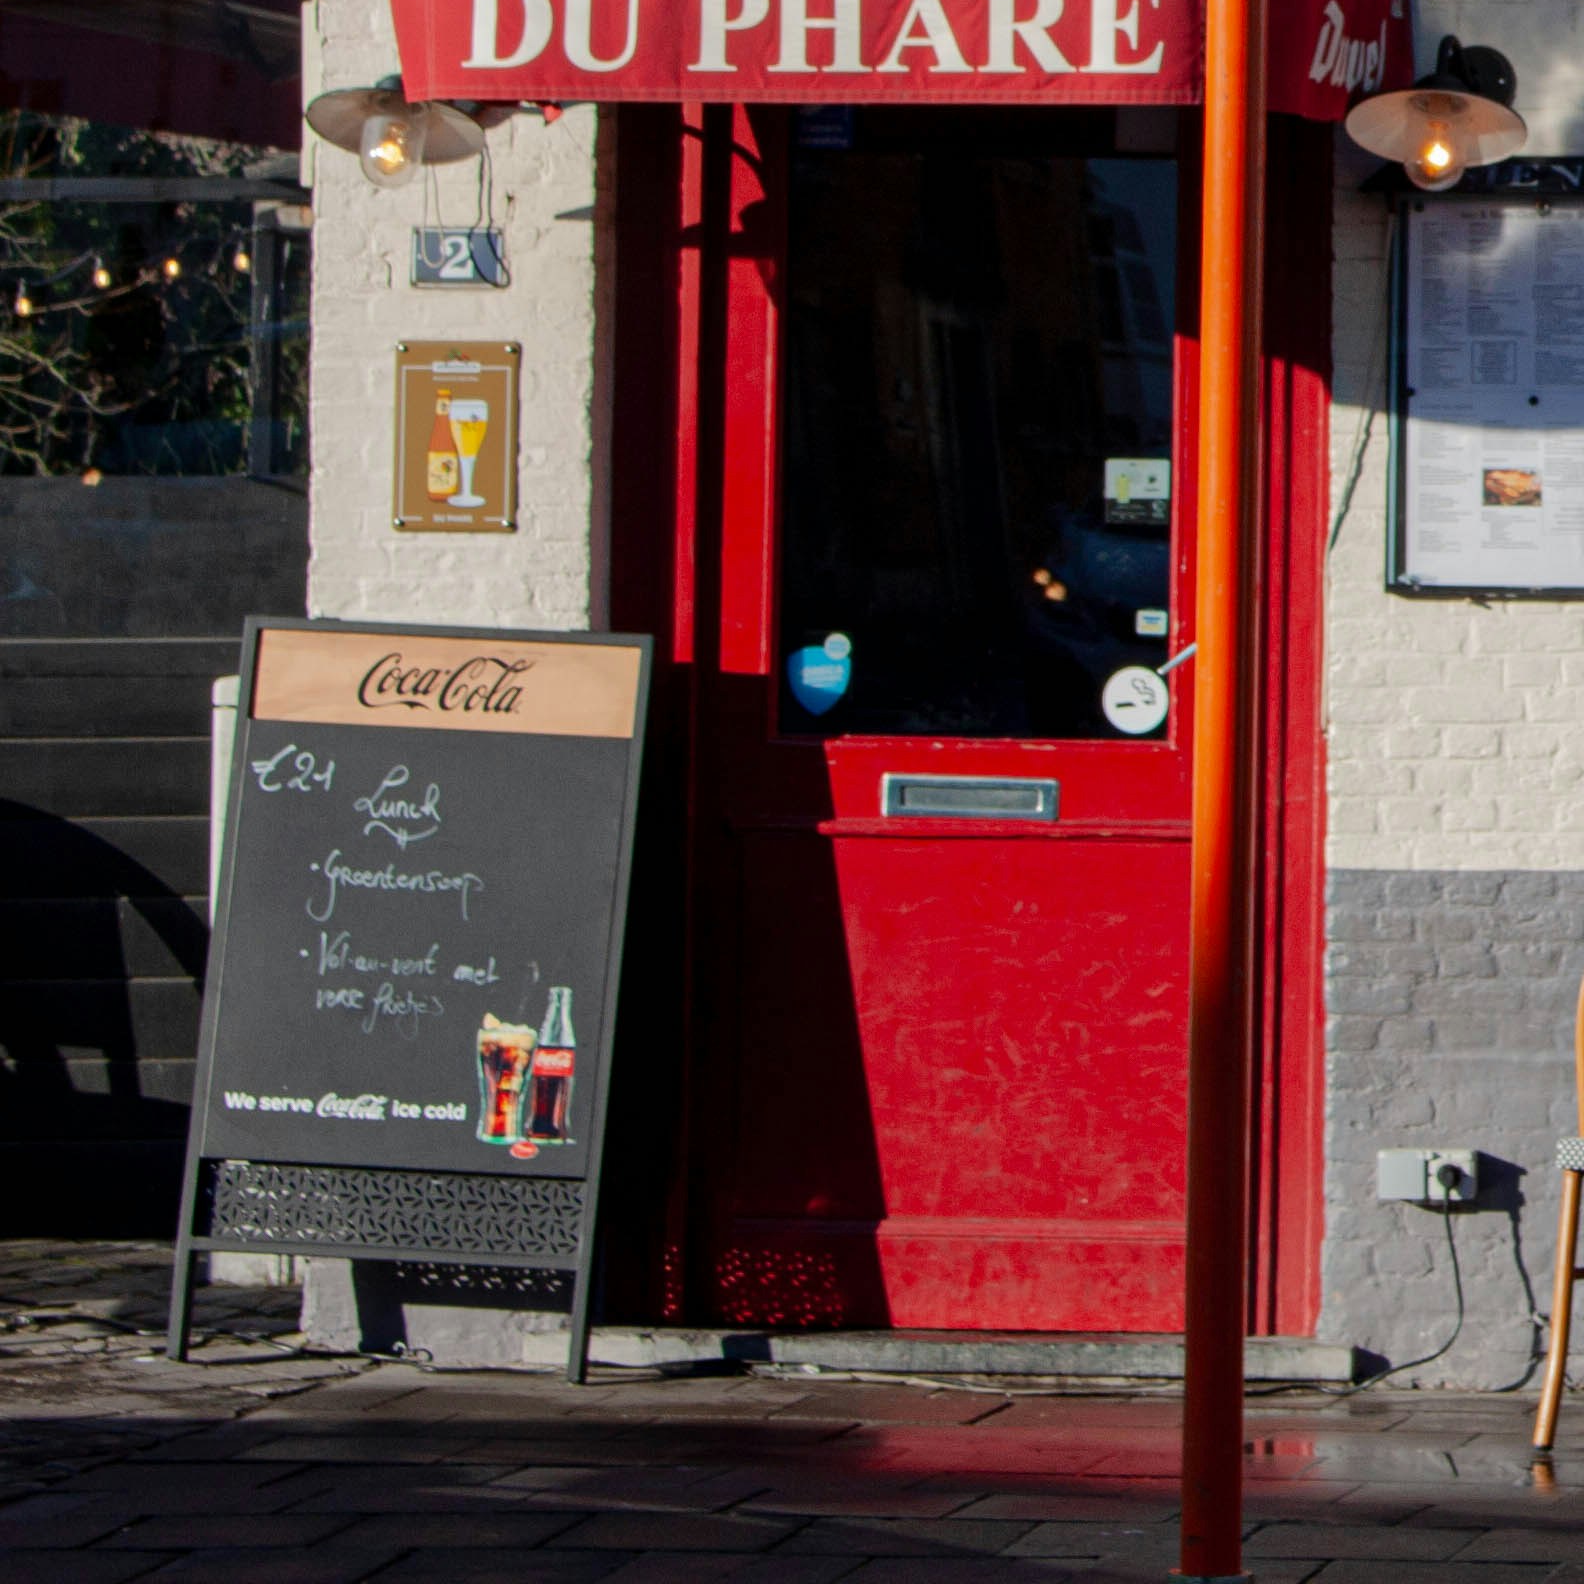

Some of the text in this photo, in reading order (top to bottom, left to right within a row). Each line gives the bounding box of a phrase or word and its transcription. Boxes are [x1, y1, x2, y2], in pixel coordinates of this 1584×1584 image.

[437, 234, 474, 279] 2
[358, 652, 537, 715] Coca-Cola
[353, 764, 442, 822] Lunch
[452, 956, 500, 985] met
[223, 1091, 257, 1111] We
[258, 1094, 314, 1114] serve
[391, 1099, 422, 1119] ice
[423, 1102, 467, 1121] cold
